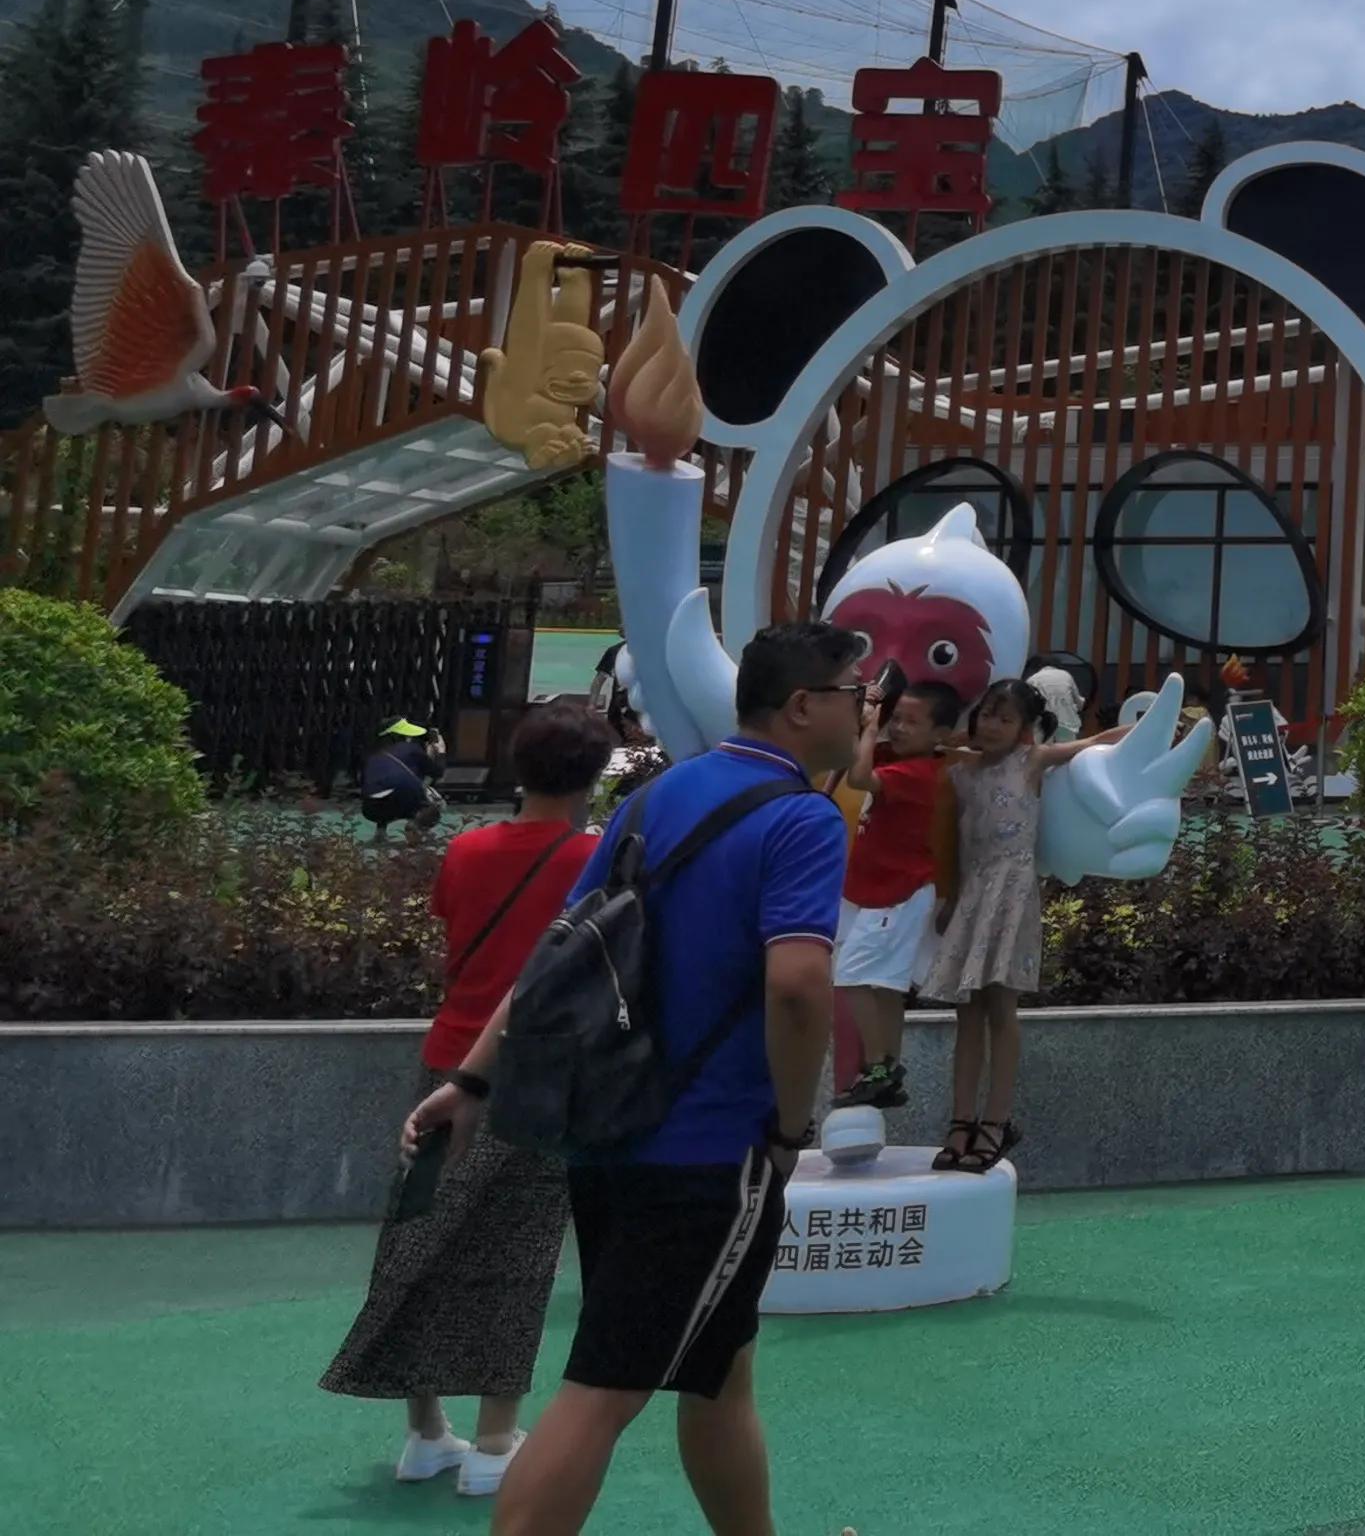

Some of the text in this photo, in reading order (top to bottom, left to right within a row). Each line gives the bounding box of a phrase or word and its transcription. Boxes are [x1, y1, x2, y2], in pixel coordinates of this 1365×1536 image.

[193, 19, 1003, 219] 秦岭四宝
[781, 1203, 927, 1238] 人民共和国
[774, 1237, 924, 1272] 四届运动会
